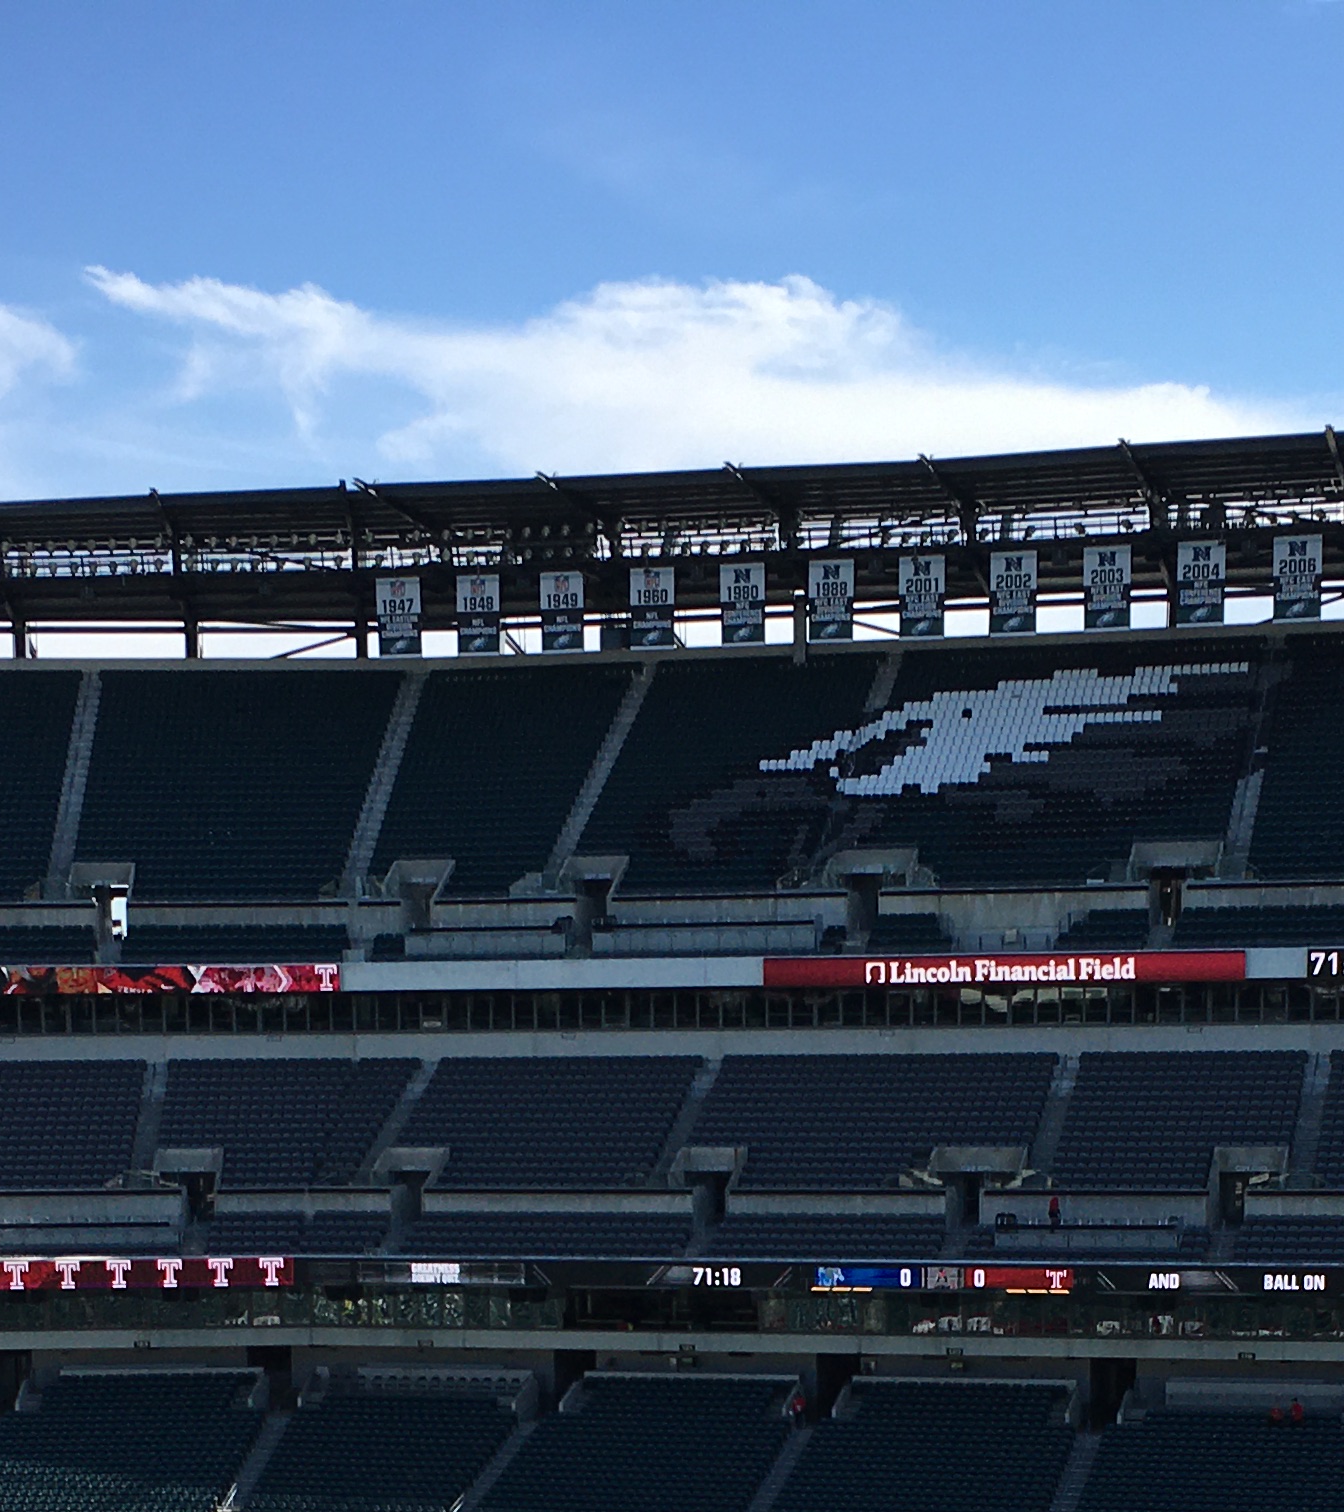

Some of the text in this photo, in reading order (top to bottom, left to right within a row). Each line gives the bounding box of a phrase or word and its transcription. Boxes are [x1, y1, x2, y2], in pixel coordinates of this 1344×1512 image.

[1183, 563, 1219, 579] 2004
[1279, 558, 1316, 575] 2006
[996, 575, 1032, 589] 2002
[1091, 569, 1124, 585] 2003
[727, 585, 759, 600] 1980
[815, 582, 847, 596] 1988
[906, 578, 940, 593] 2001
[463, 597, 493, 610] 1948
[547, 594, 578, 608] 1949
[637, 589, 668, 604] 1960
[382, 599, 413, 613] 1947
[889, 957, 1136, 984] Lincoln Financial Field
[692, 1268, 741, 1286] 71:18
[900, 1268, 912, 1287] 0
[973, 1269, 985, 1288] 0
[1148, 1273, 1179, 1290] AND
[1264, 1274, 1325, 1291] BALL ON
